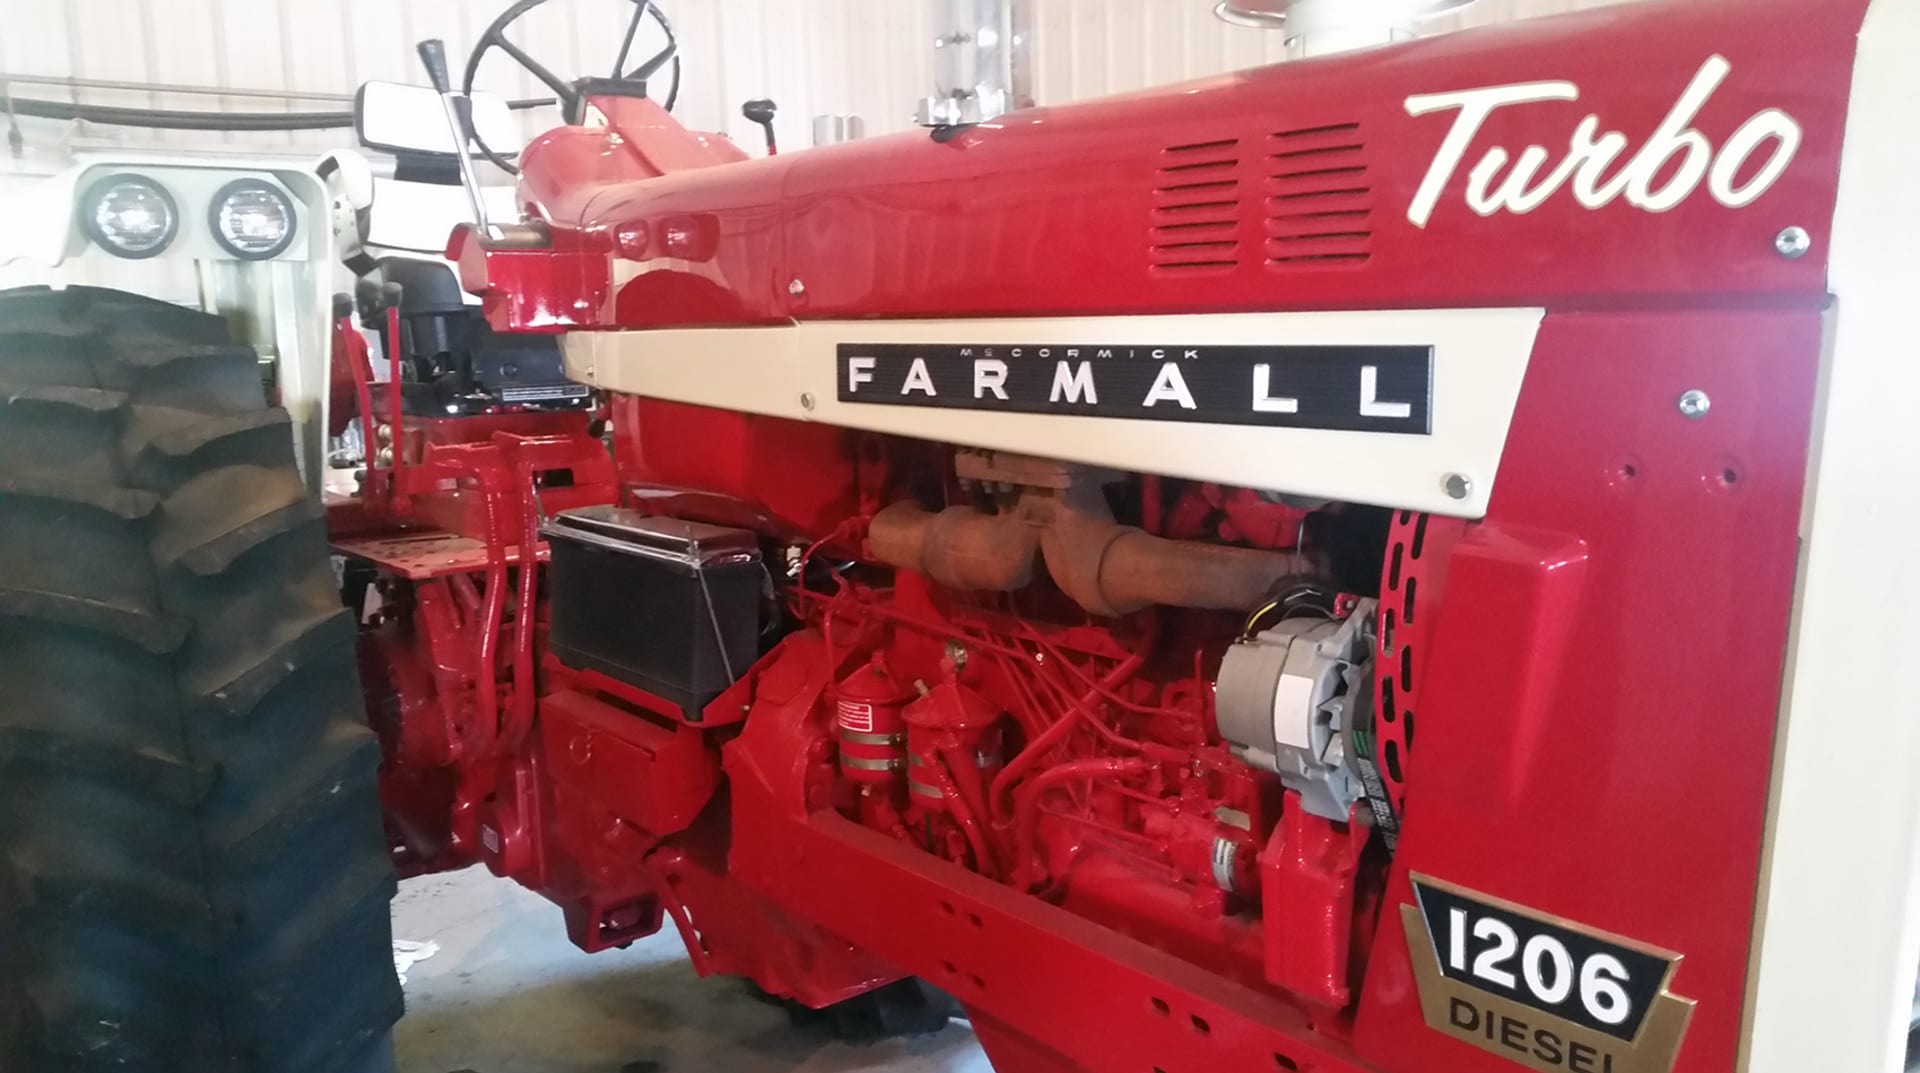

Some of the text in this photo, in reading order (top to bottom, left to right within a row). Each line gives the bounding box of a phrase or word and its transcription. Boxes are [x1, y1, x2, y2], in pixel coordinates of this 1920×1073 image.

[1404, 53, 1802, 228] Turbo
[848, 357, 1411, 418] FARMALL
[1449, 906, 1632, 1025] 1206
